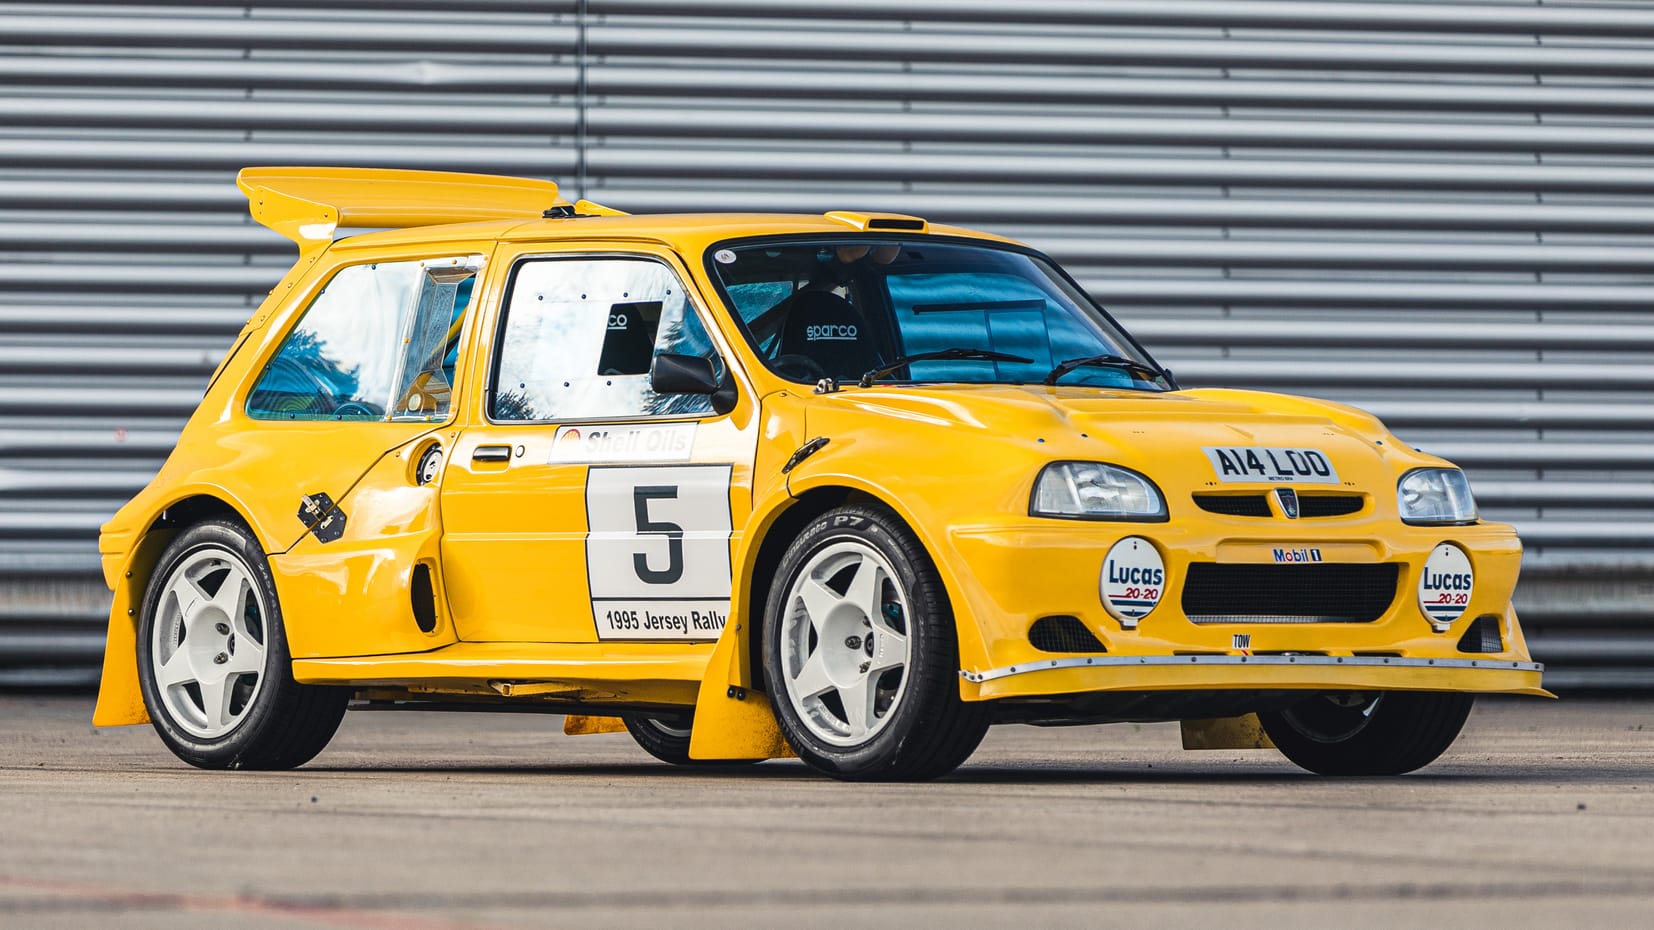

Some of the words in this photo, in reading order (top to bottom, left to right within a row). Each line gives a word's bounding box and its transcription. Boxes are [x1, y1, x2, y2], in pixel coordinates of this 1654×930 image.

[806, 324, 857, 341] sparco
[586, 431, 640, 451] Shell
[646, 429, 687, 451] Oils
[1215, 448, 1266, 475] A14
[833, 515, 864, 527] P7
[633, 485, 684, 585] 5
[1273, 549, 1309, 562] Mobil
[1311, 549, 1322, 562] 1
[1109, 559, 1163, 586] Lucas
[1423, 566, 1472, 591] Lucas
[1125, 587, 1159, 600] 20-20
[1439, 593, 1468, 605] 20-20
[607, 610, 640, 630] 1995
[643, 610, 688, 635] Jersey
[691, 610, 726, 630] Rally
[1233, 634, 1250, 649] TOW
